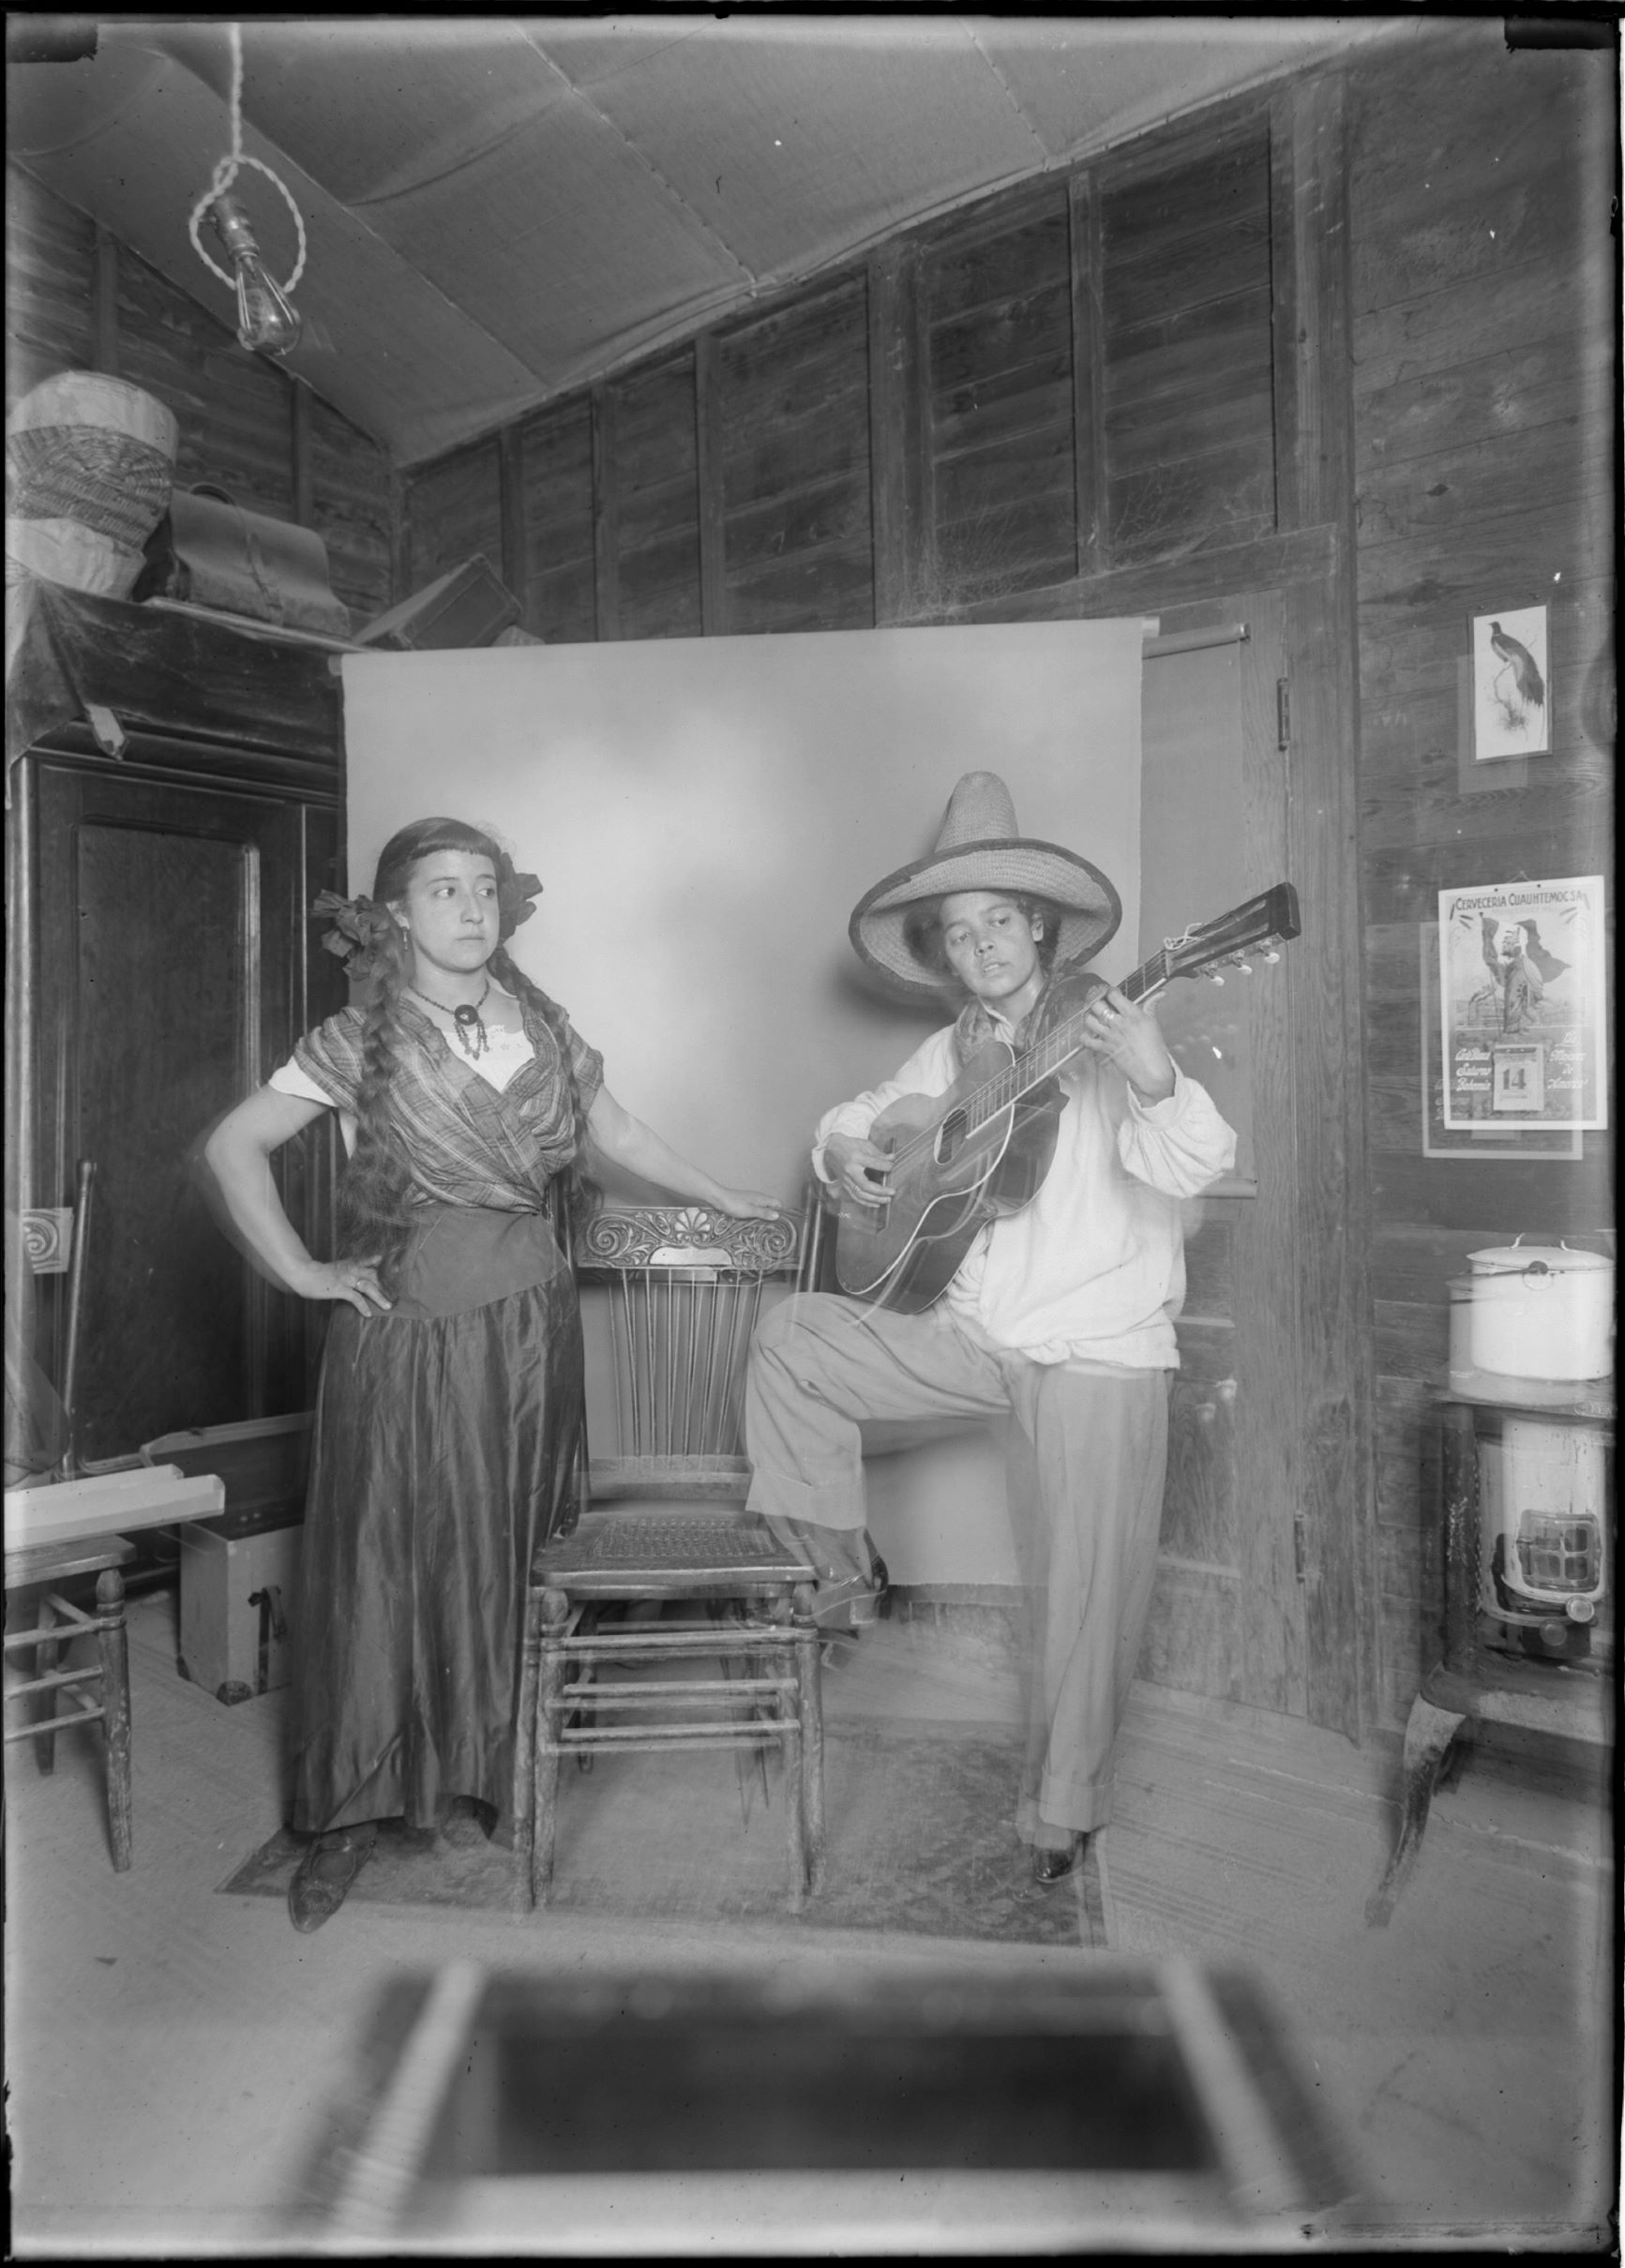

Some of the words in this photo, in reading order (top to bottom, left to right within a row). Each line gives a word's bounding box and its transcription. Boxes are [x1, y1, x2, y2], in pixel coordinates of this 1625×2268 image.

[1454, 895, 1507, 910] CERVECERIA
[1508, 891, 1568, 907] CUAUHTEMOC
[1503, 1068, 1527, 1090] 14
